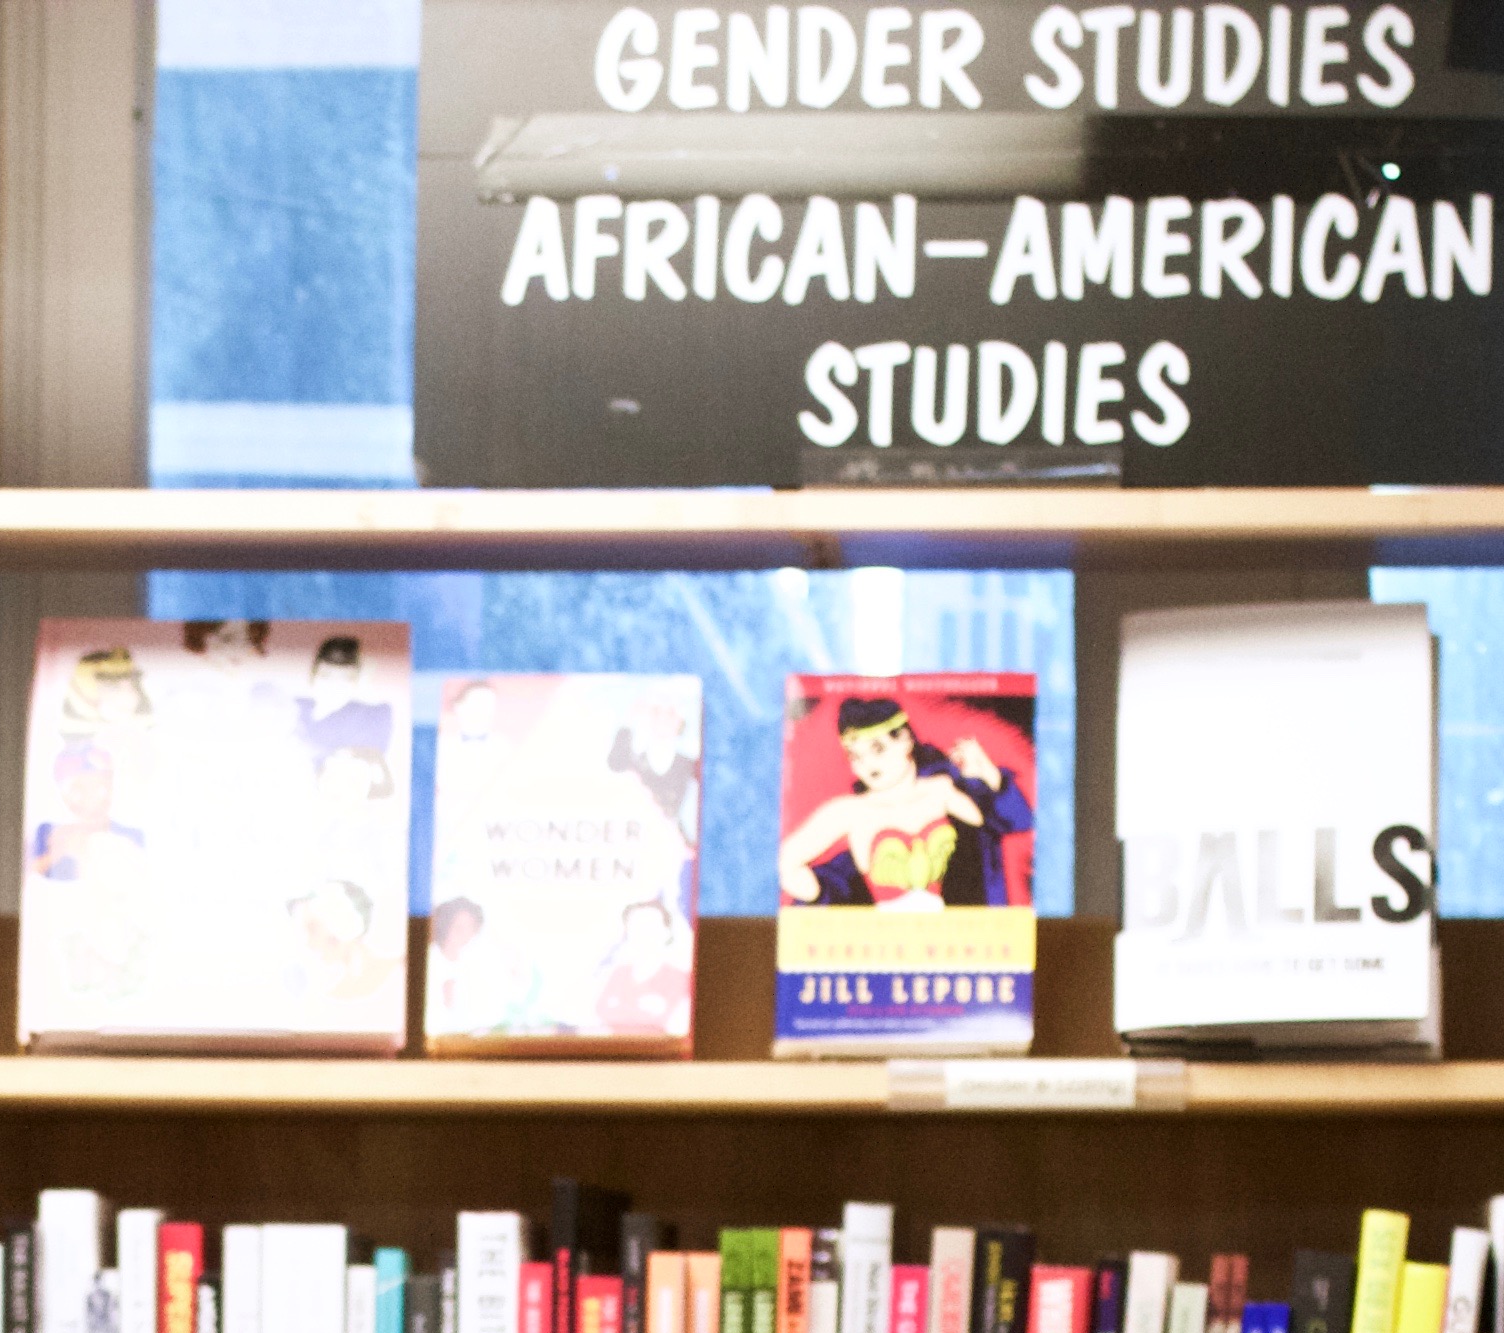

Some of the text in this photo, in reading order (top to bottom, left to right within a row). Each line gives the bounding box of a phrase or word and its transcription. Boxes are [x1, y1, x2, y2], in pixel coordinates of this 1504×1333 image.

[591, 2, 1417, 113] GENDER STUDIES
[499, 192, 1496, 306] AFRICAN-AMERICAN
[796, 338, 1193, 448] STUDIES
[485, 819, 644, 845] WONDER
[491, 856, 635, 882] WOMEN
[1124, 824, 1435, 943] BALLS
[798, 974, 1017, 1004] JILL LEPORE
[476, 1229, 508, 1279] THE
